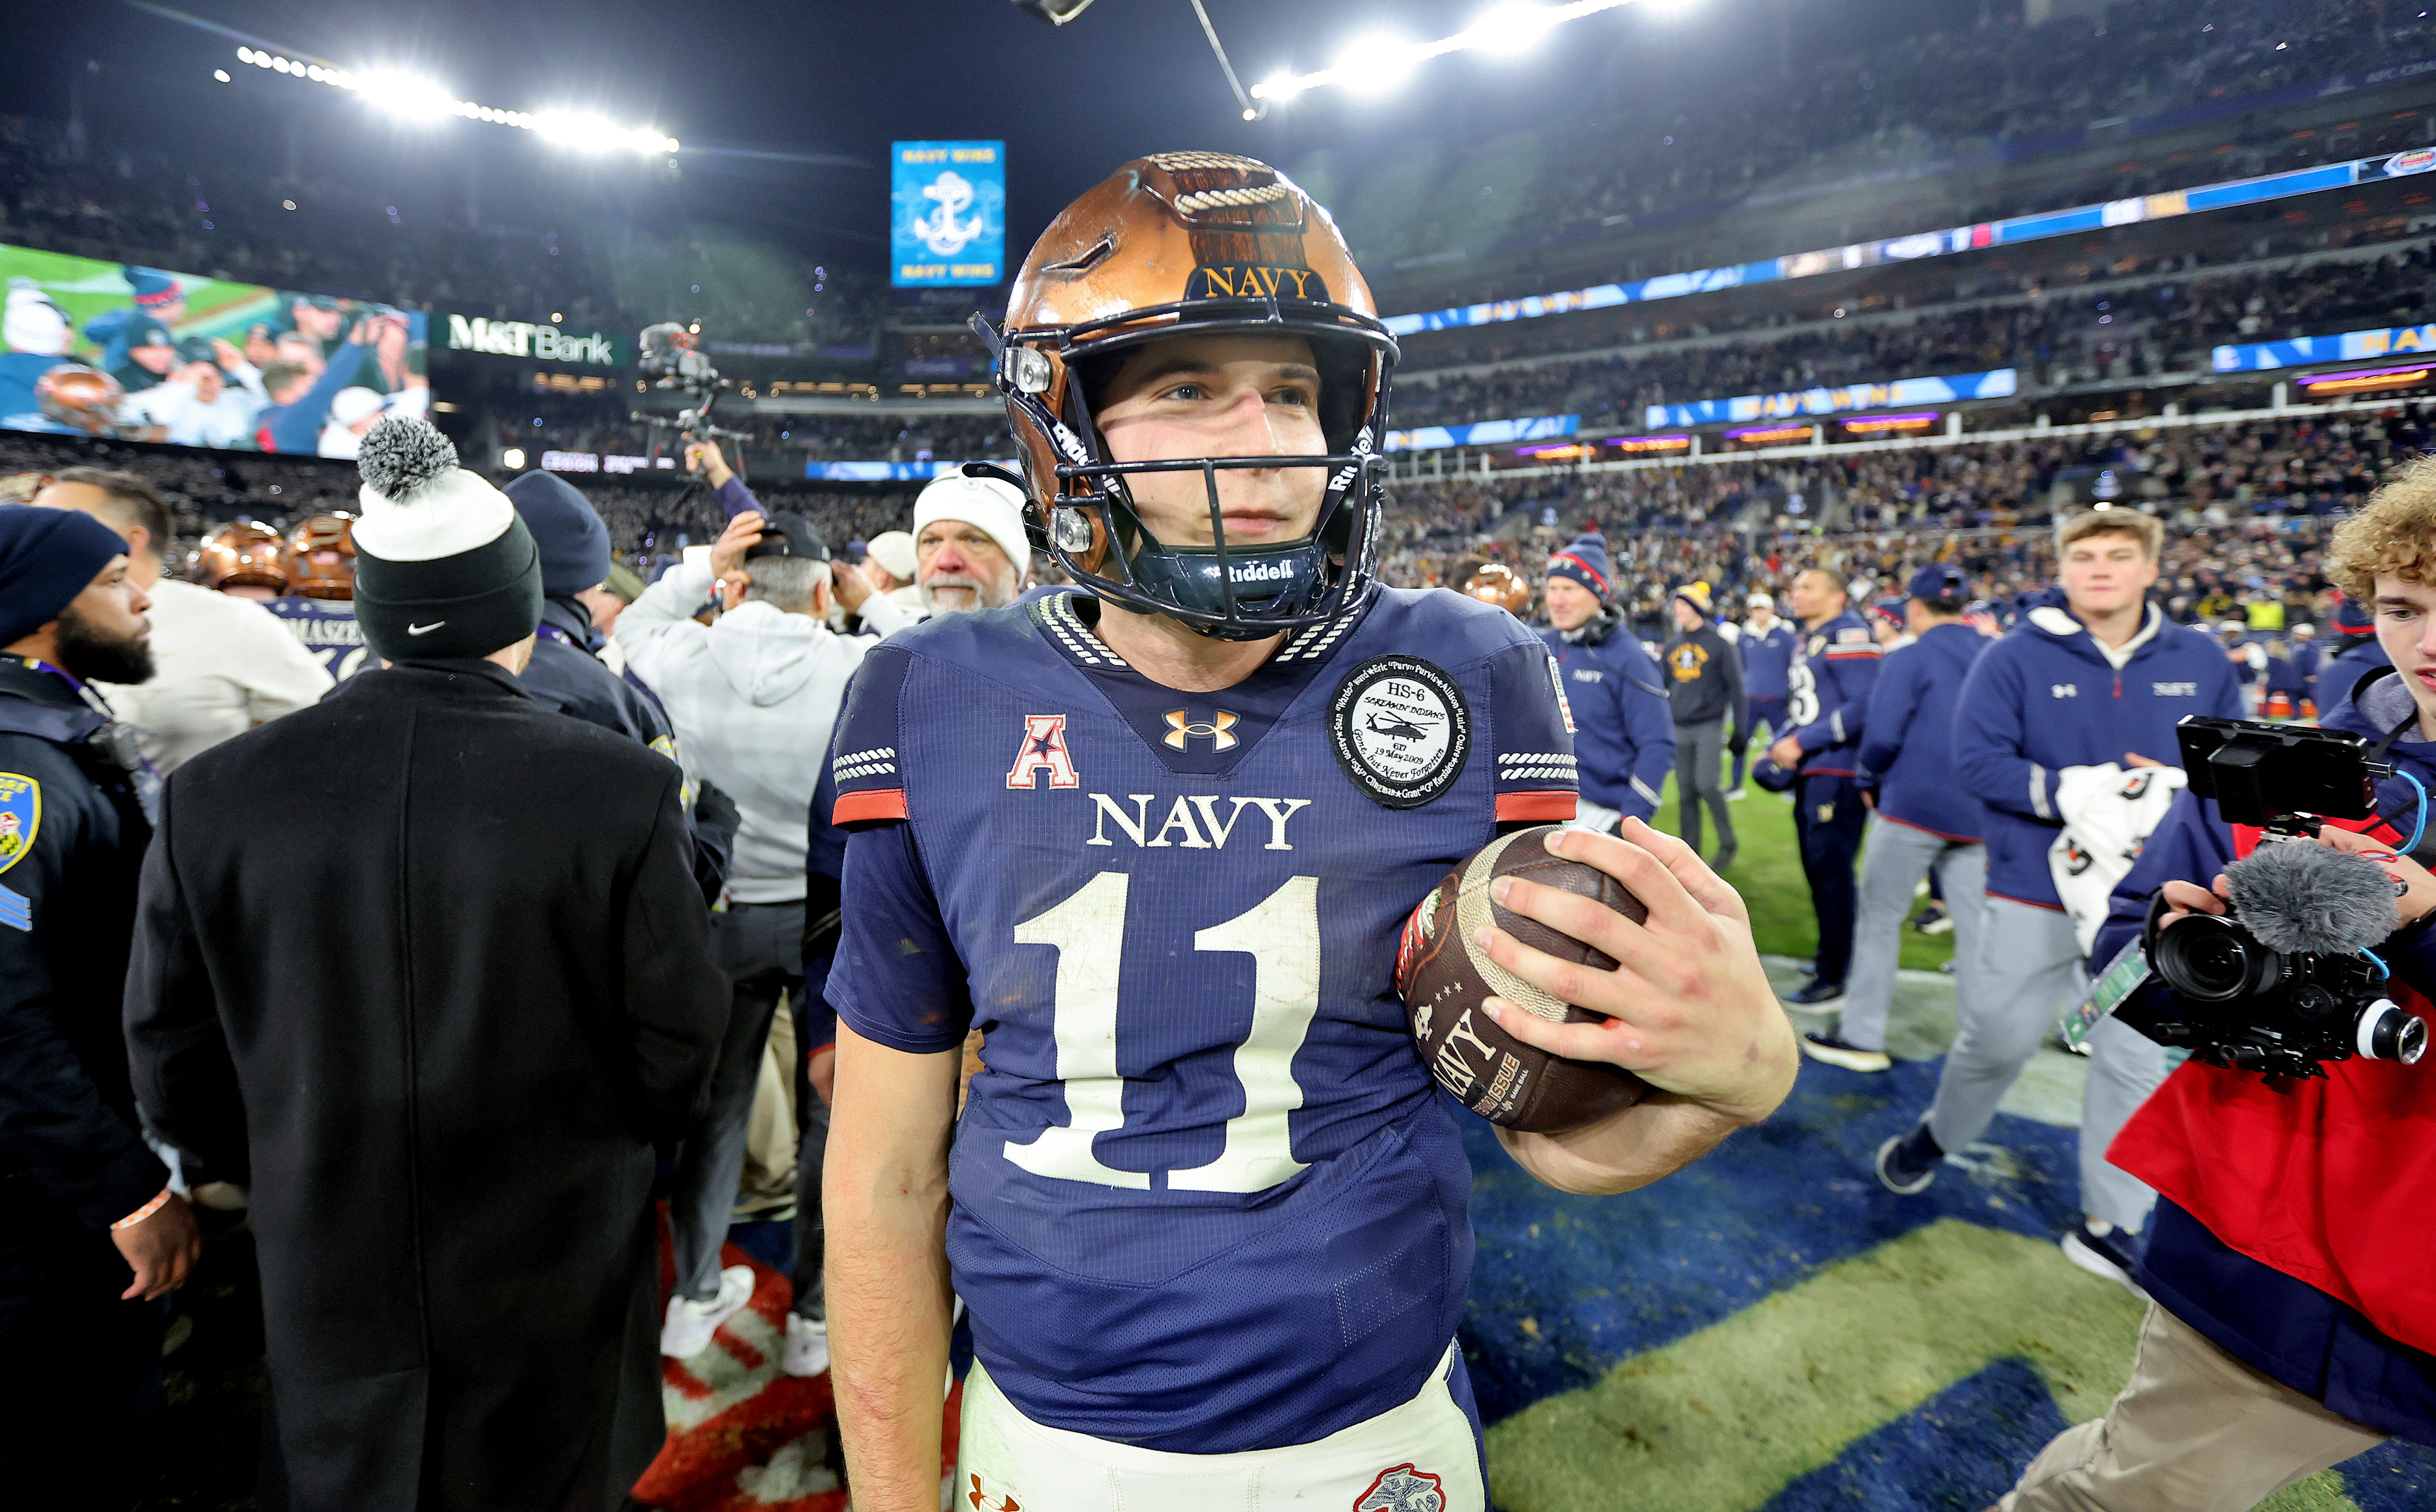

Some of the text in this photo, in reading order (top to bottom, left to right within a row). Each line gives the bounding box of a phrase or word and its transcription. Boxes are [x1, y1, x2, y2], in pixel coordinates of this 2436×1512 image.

[1203, 267, 1312, 299] NAVY
[447, 313, 614, 366] M&T Bank
[1387, 681, 1425, 702] HS-6
[1334, 713, 1344, 730] Sean
[1367, 754, 1381, 769] but
[1381, 765, 1409, 779] Never
[1411, 747, 1444, 779] Forgotten
[1374, 747, 1424, 765] 19 May 2009
[1393, 743, 1407, 751] 617
[1086, 792, 1312, 851] NAVY
[1002, 871, 1320, 1194] 11
[1488, 1051, 1521, 1102] ISSUE
[1518, 1069, 1529, 1085] BALL
